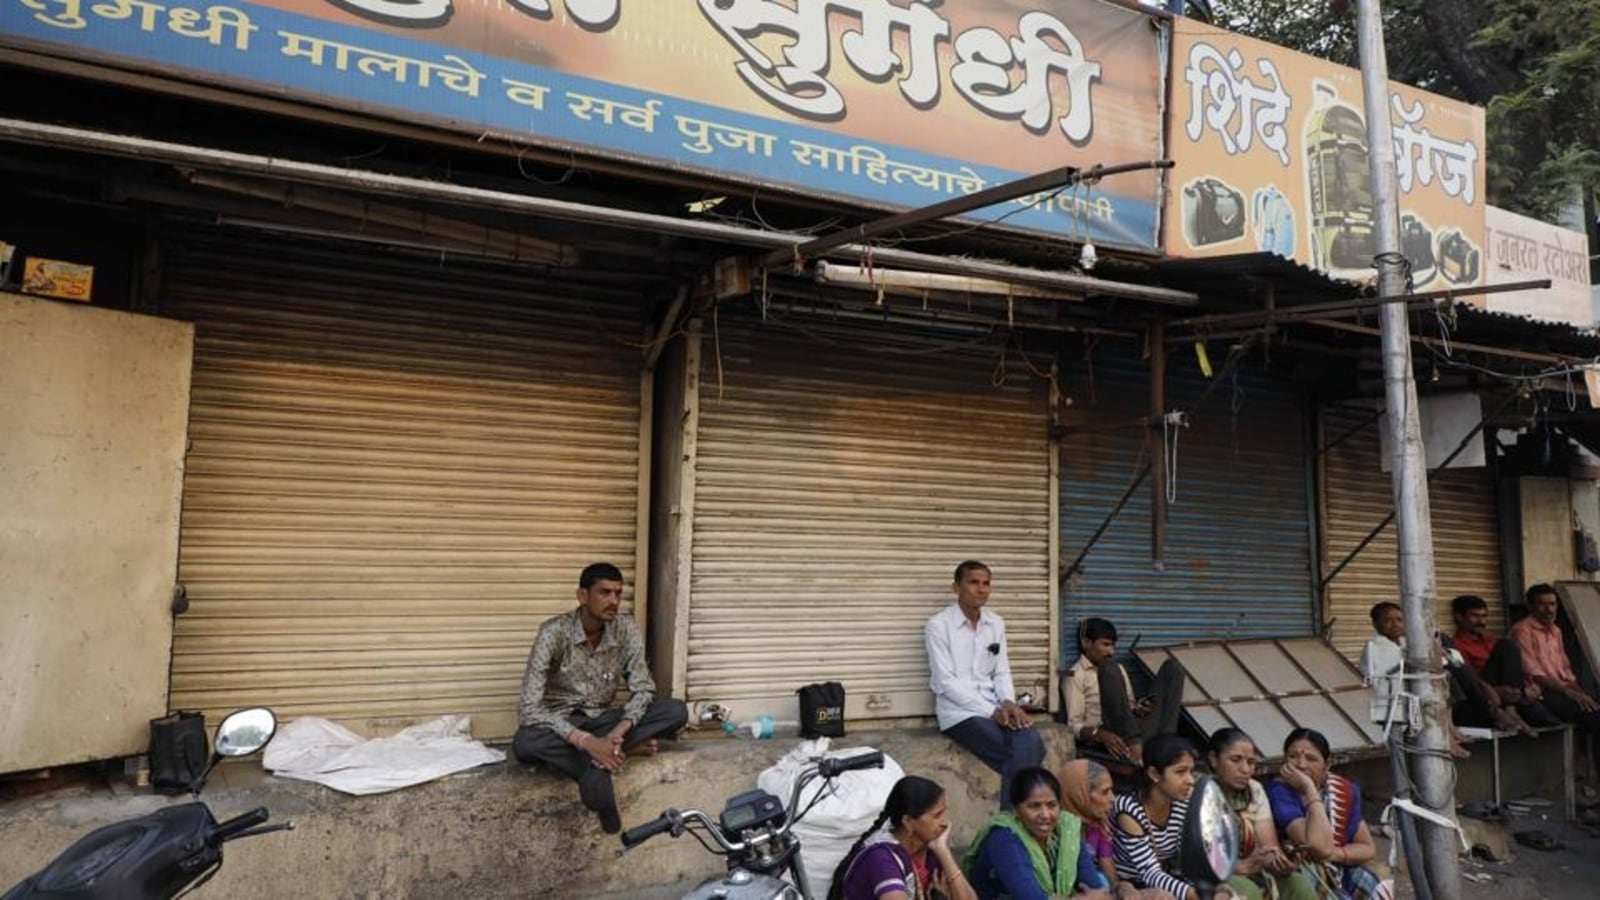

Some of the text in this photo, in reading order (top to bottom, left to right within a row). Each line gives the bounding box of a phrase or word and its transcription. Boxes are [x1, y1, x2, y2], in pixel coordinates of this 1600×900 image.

[278, 29, 486, 97] मालाचे
[503, 78, 550, 111] व
[566, 90, 664, 134] सर्व
[672, 114, 777, 158] पुजा
[790, 139, 988, 197] साहित्याचे
[1185, 40, 1292, 167] शिंदे
